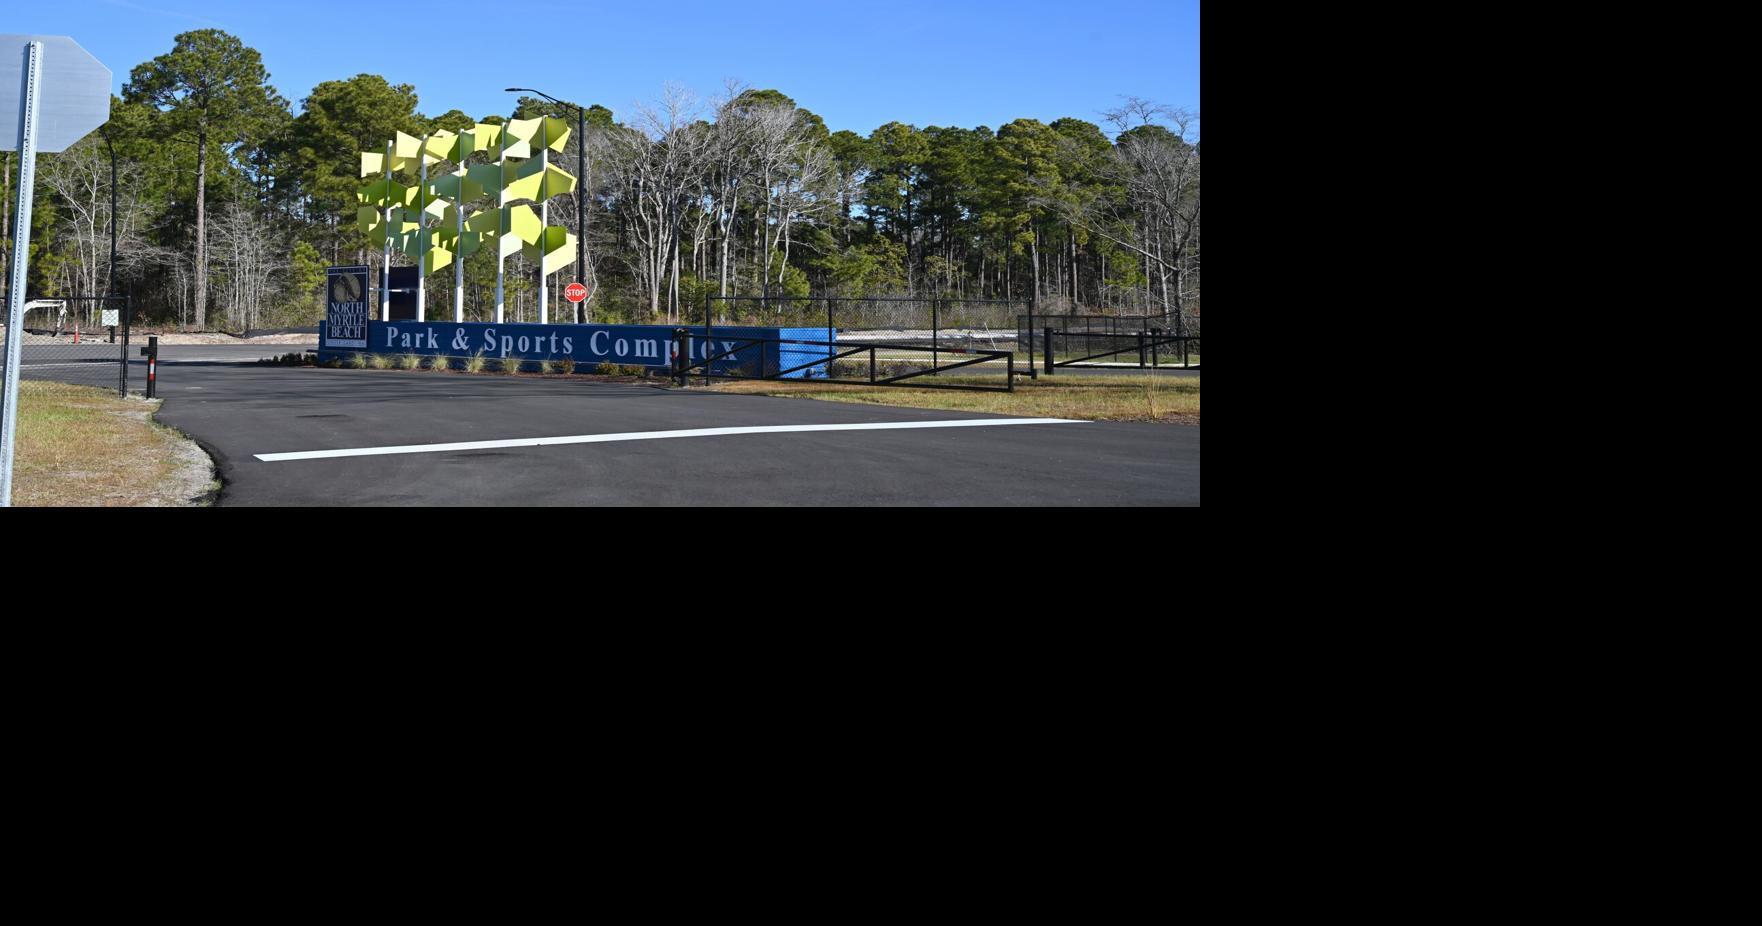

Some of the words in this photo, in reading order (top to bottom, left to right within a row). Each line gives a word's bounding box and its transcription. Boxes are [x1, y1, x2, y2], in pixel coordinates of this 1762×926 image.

[566, 289, 585, 297] STOP
[331, 302, 363, 314] NORTH
[329, 314, 365, 326] MYRTLE
[331, 326, 361, 338] BEACH
[385, 326, 439, 349] Park
[451, 327, 470, 350] &
[484, 328, 573, 358] Sports
